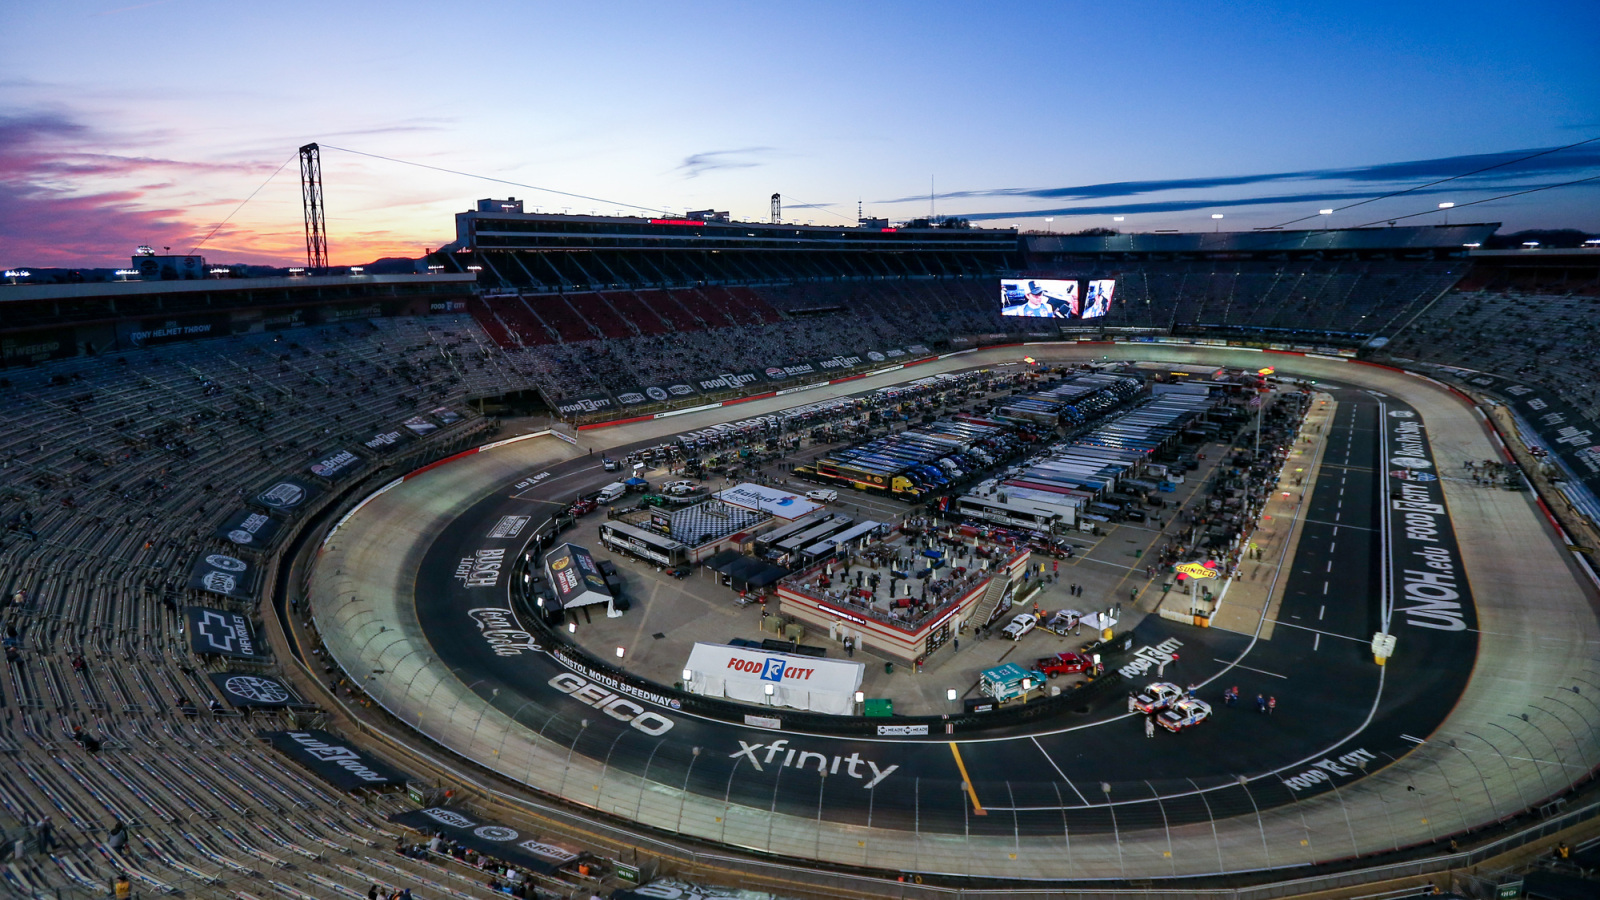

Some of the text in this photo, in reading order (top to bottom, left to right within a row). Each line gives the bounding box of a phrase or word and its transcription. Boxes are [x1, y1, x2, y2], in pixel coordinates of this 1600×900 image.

[132, 331, 151, 340] TONY
[152, 327, 183, 338] HELMET
[184, 323, 212, 333] THROW
[783, 363, 813, 376] Bristol
[700, 373, 757, 390] FOOD CITY
[559, 398, 610, 413] FOOD CITY
[321, 450, 353, 469] Bristol
[732, 487, 777, 503] Ballad
[1402, 483, 1430, 504] CITY
[1405, 512, 1439, 543] FOOD
[454, 556, 475, 579] LIGHT
[464, 548, 506, 589] BUSCH
[1178, 565, 1215, 578] SUNOCO
[1403, 546, 1468, 632] UNOH.edu
[233, 614, 254, 655] CHEVROLET
[727, 657, 814, 680] FOOD CITY
[1118, 637, 1184, 679] FOOD CITY
[559, 653, 672, 706] BRISTOL MOTOR SPEEDWAY
[547, 672, 675, 736] GEICO
[286, 731, 388, 781] FOOD CITY
[1282, 747, 1377, 791] FOOD CITY
